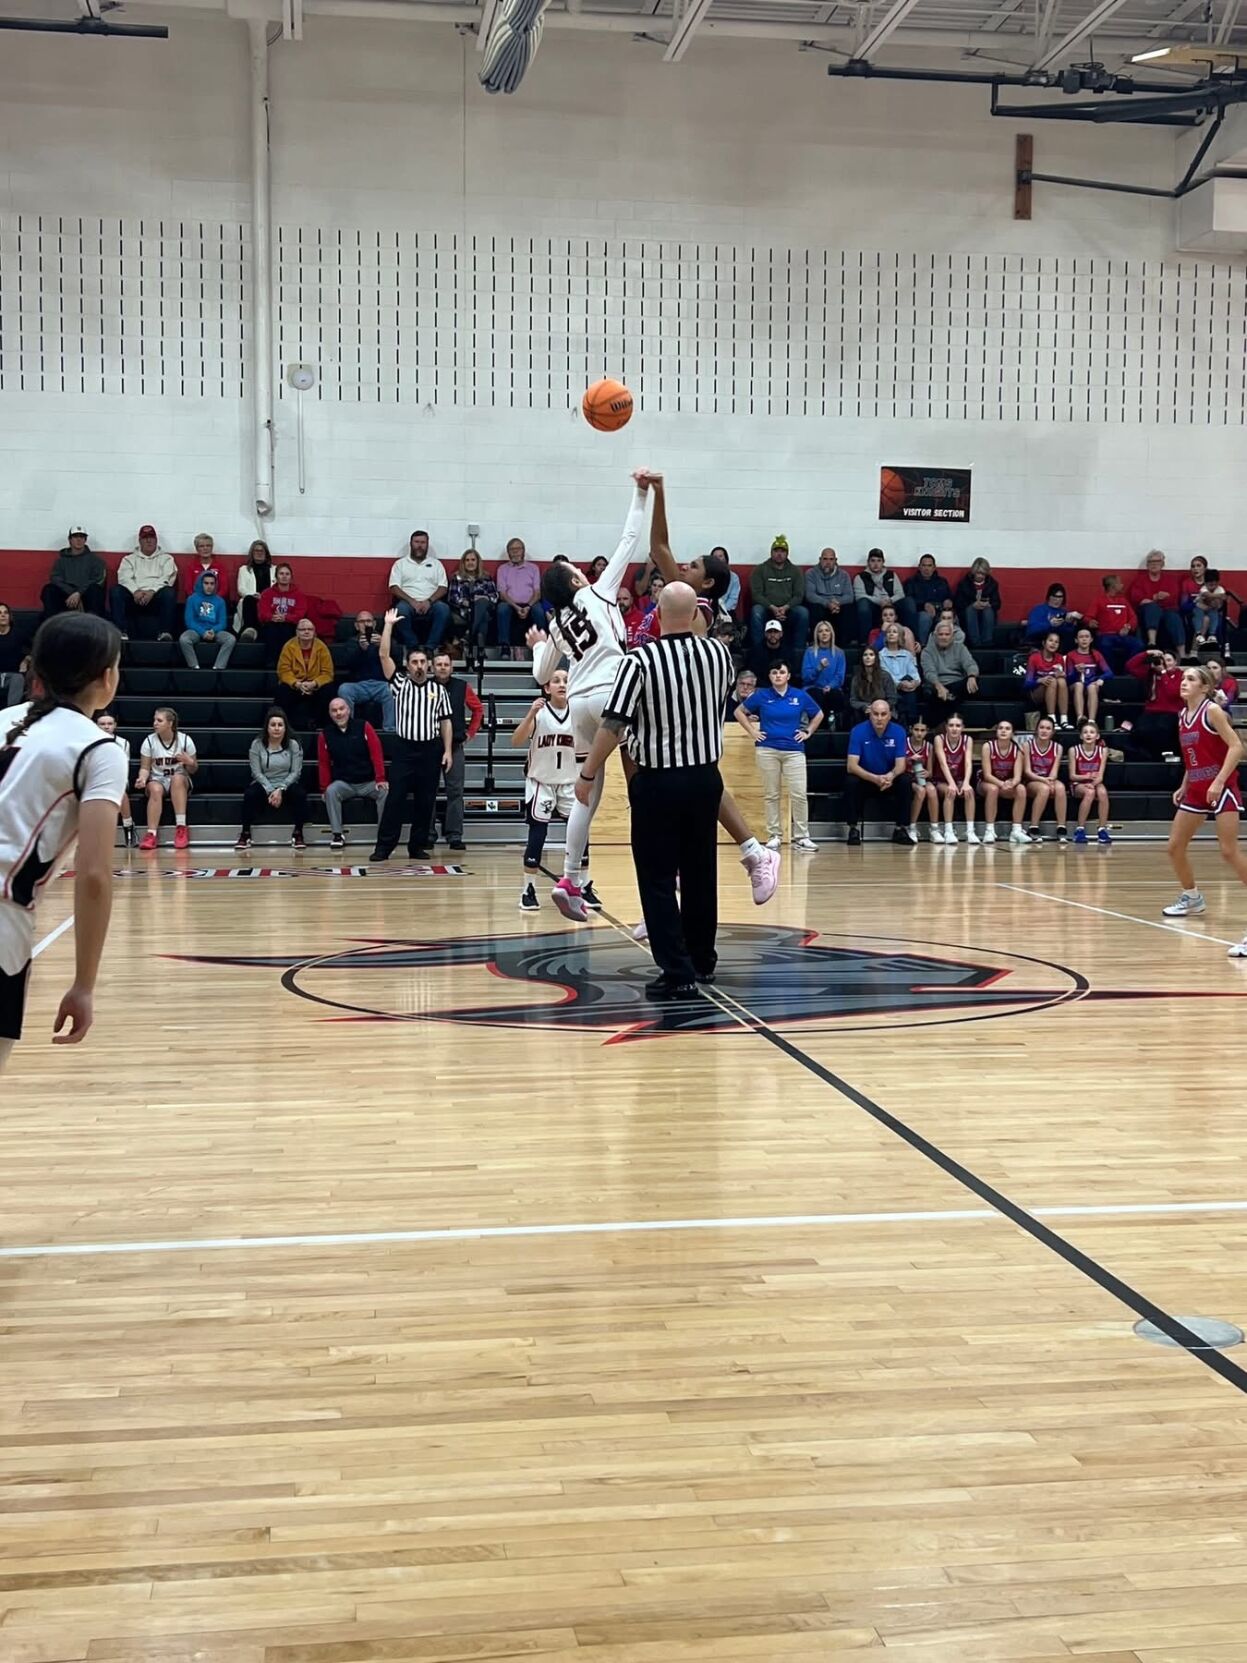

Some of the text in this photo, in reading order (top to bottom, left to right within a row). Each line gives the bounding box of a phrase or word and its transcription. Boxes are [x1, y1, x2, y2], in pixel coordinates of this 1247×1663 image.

[902, 507, 965, 519] VISITOR SECTION
[538, 733, 556, 749] LADY
[556, 751, 562, 769] 1
